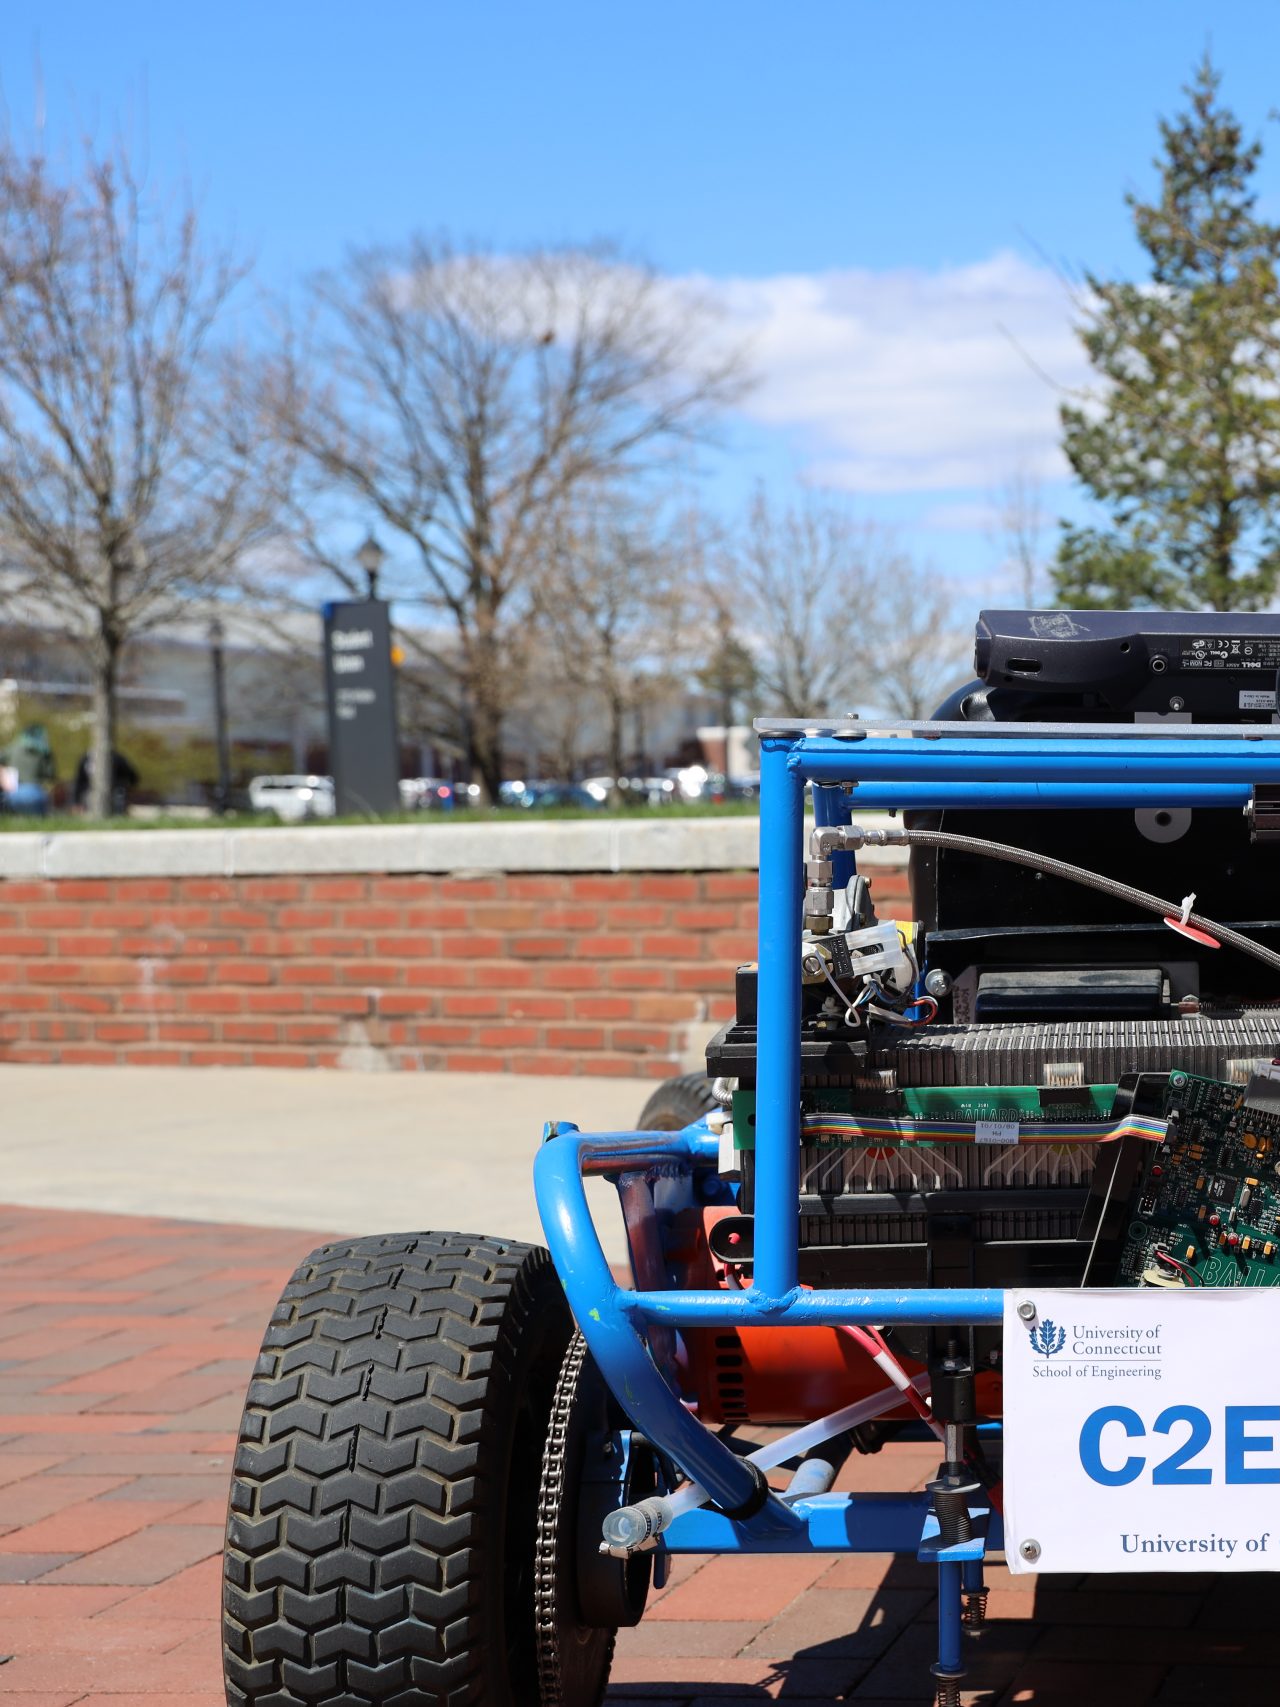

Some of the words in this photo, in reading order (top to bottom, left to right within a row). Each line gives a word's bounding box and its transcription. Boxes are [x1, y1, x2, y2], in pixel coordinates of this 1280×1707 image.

[1073, 1324, 1143, 1343] University
[1146, 1324, 1161, 1338] of
[1072, 1341, 1162, 1355] Connecticut
[1032, 1365, 1072, 1377] School
[1075, 1365, 1088, 1377] of
[1092, 1365, 1162, 1381] Engineering
[1121, 1533, 1238, 1559] University
[1245, 1532, 1270, 1552] of
